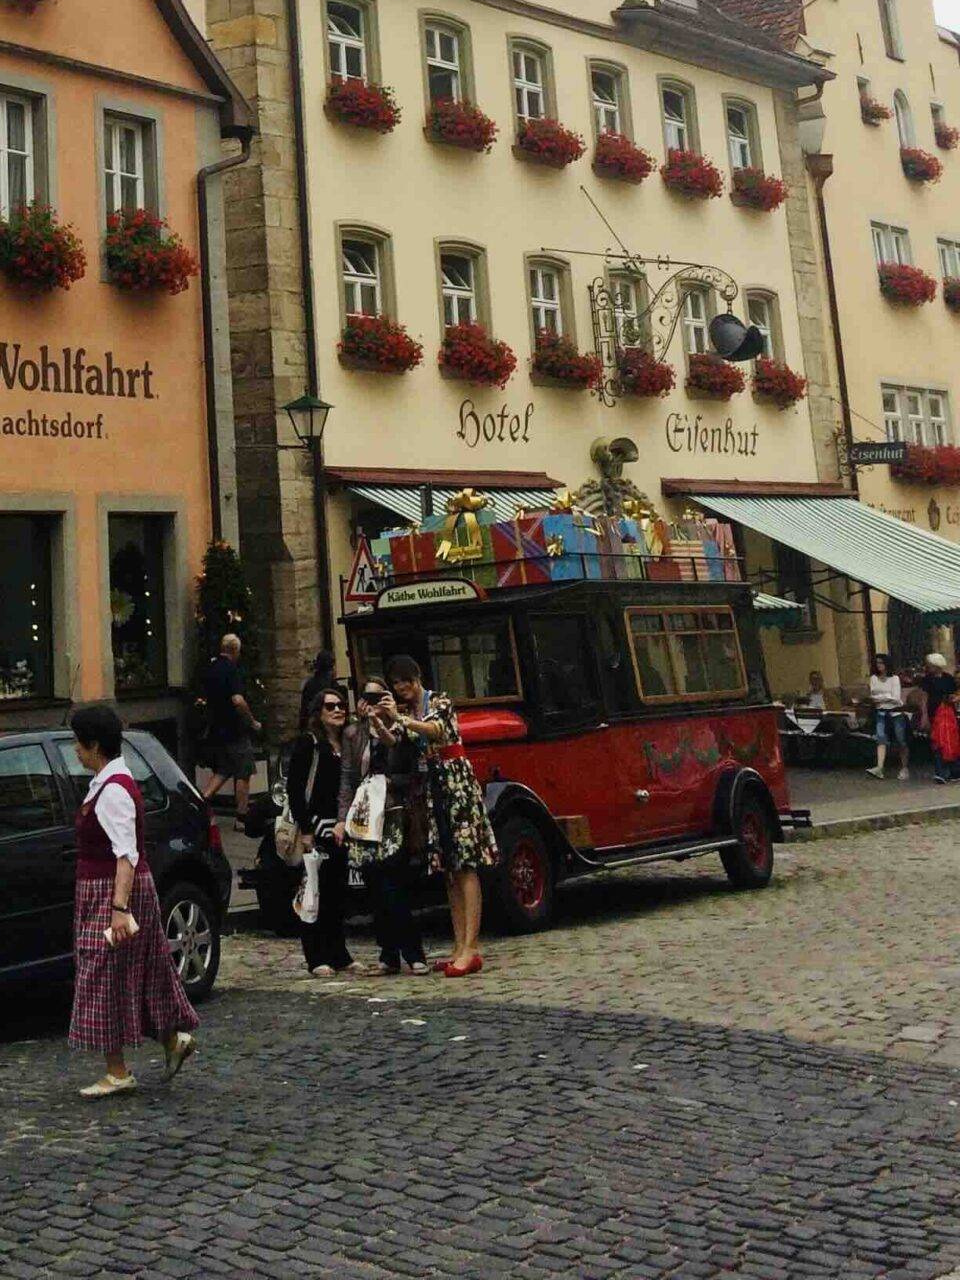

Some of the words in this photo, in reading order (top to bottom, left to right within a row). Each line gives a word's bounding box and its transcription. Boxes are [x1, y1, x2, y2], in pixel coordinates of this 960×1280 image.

[456, 398, 535, 449] Hotel
[387, 589, 416, 602] Käthe
[417, 586, 466, 599] Wohlfahrt
